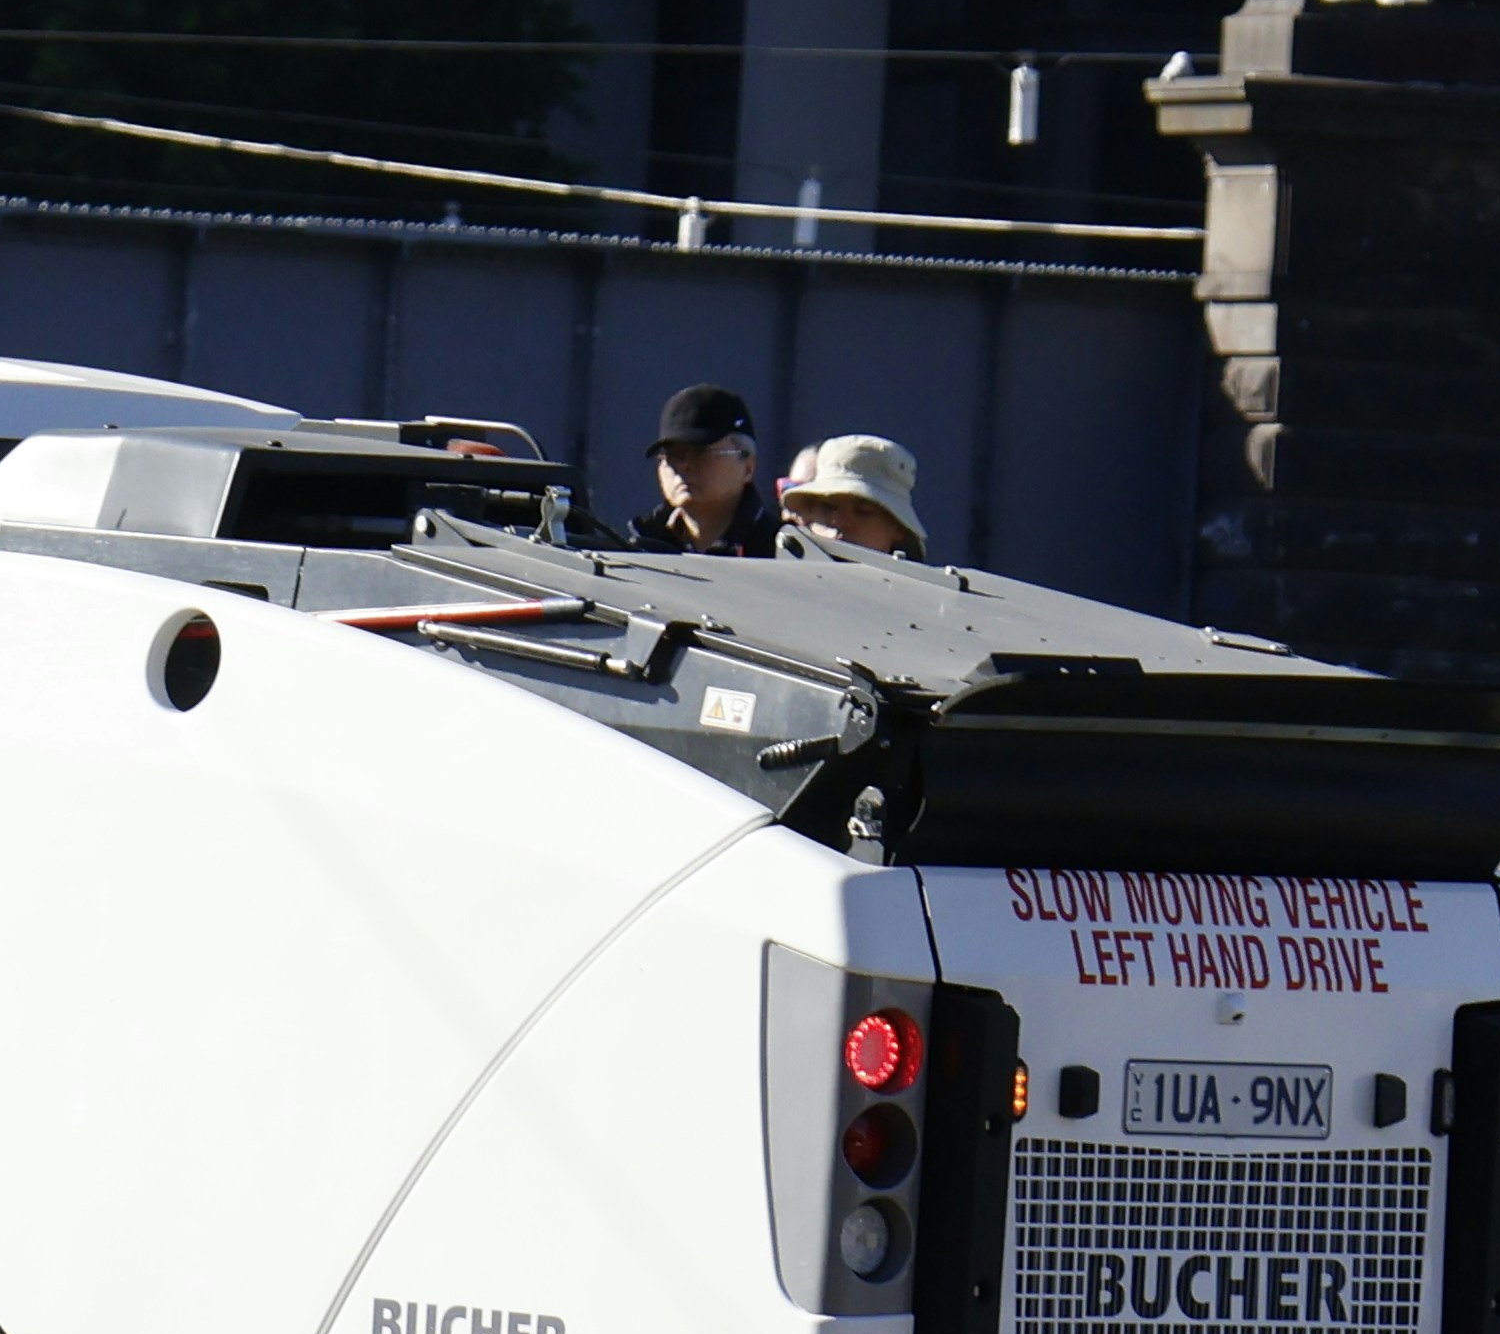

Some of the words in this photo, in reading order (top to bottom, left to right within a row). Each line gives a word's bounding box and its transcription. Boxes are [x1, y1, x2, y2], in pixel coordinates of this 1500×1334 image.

[1006, 868, 1112, 923] SLOW
[1118, 870, 1271, 928] MOVING
[1270, 876, 1429, 933] VEHICLE
[1070, 929, 1155, 986] LEFT
[1166, 932, 1271, 989] HAND
[1277, 935, 1390, 993] DRIVE
[1085, 1254, 1348, 1322] BUCHER
